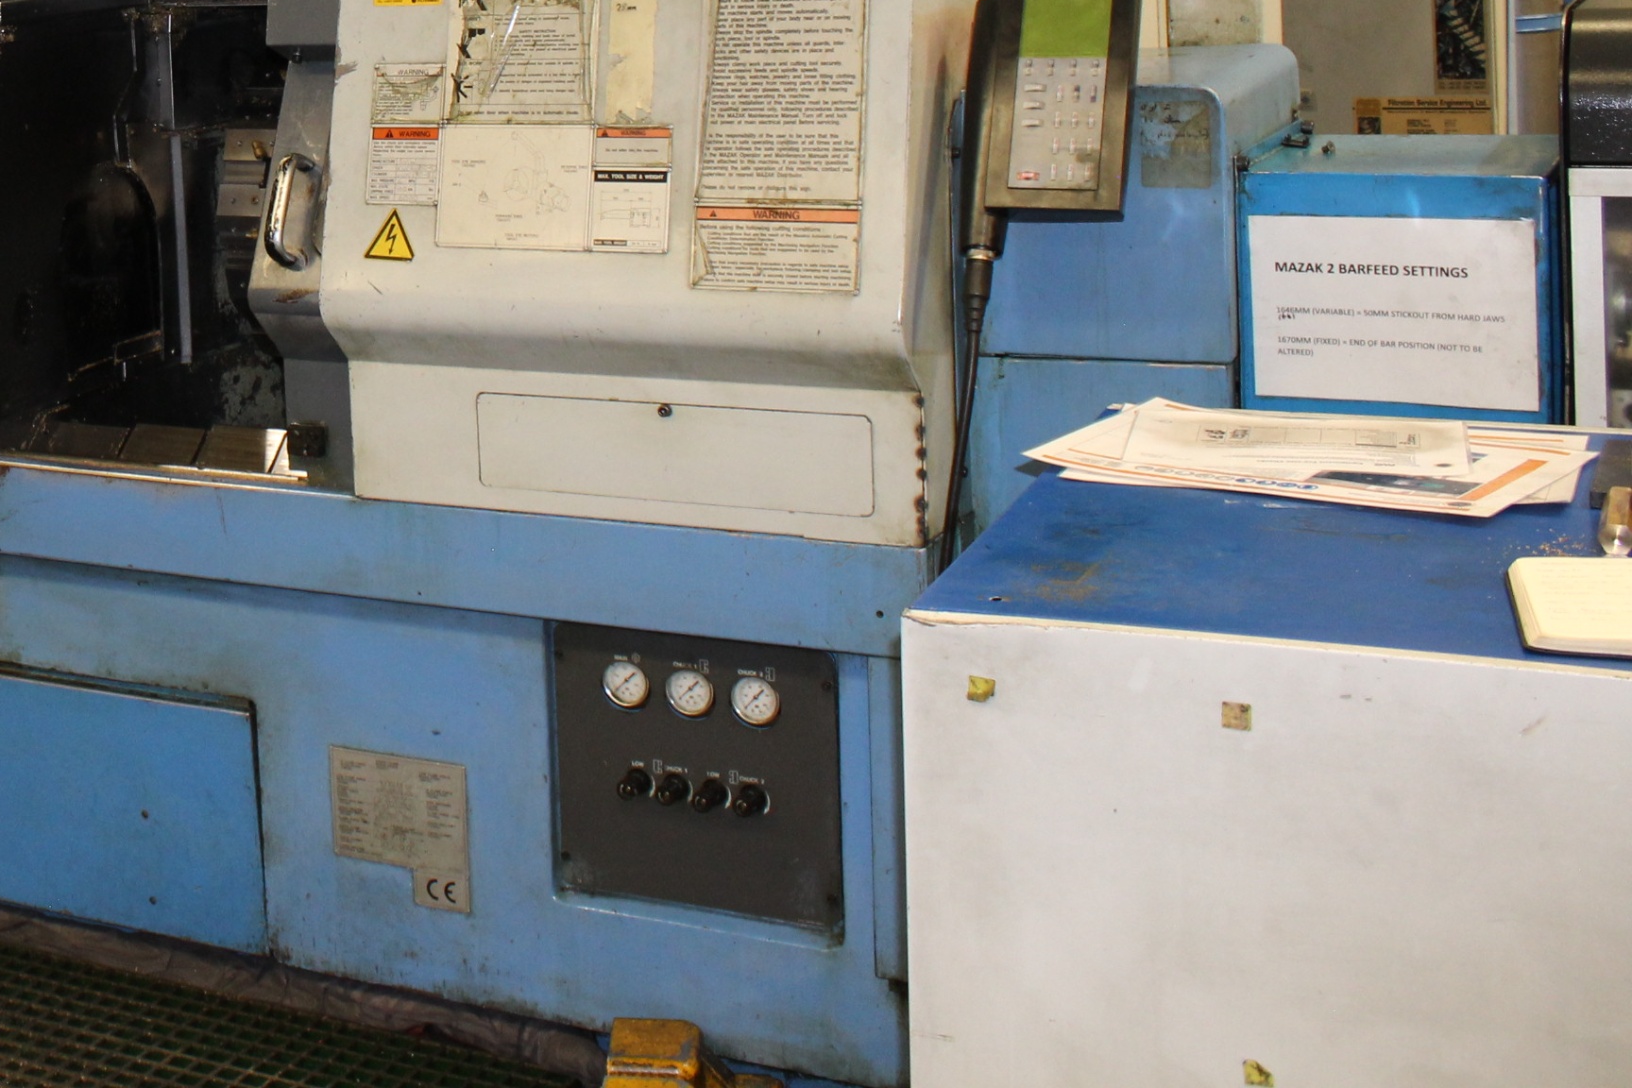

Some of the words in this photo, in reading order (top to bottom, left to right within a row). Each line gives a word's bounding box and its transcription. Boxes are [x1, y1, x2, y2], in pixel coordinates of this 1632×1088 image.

[399, 129, 431, 137] WARNING
[753, 210, 800, 220] WARNING
[1274, 262, 1323, 274] MAZAK
[1327, 264, 1334, 274] 2
[1338, 264, 1399, 276] BARFEED
[1403, 266, 1468, 278] SETTINGS
[1312, 307, 1355, 317] (VARIABLE)
[1391, 311, 1429, 320] STICKOUT
[1431, 313, 1456, 321] FROM
[1458, 314, 1480, 322] HARD
[1483, 315, 1505, 323] JAWS
[1278, 336, 1311, 344] 1670MM
[1313, 337, 1340, 346] (FIXED)
[1380, 340, 1396, 348] BAR
[1398, 341, 1435, 350] POSITION
[1437, 343, 1457, 352] (NOT
[1472, 345, 1482, 353] BE
[1278, 348, 1314, 357] ALTERED)
